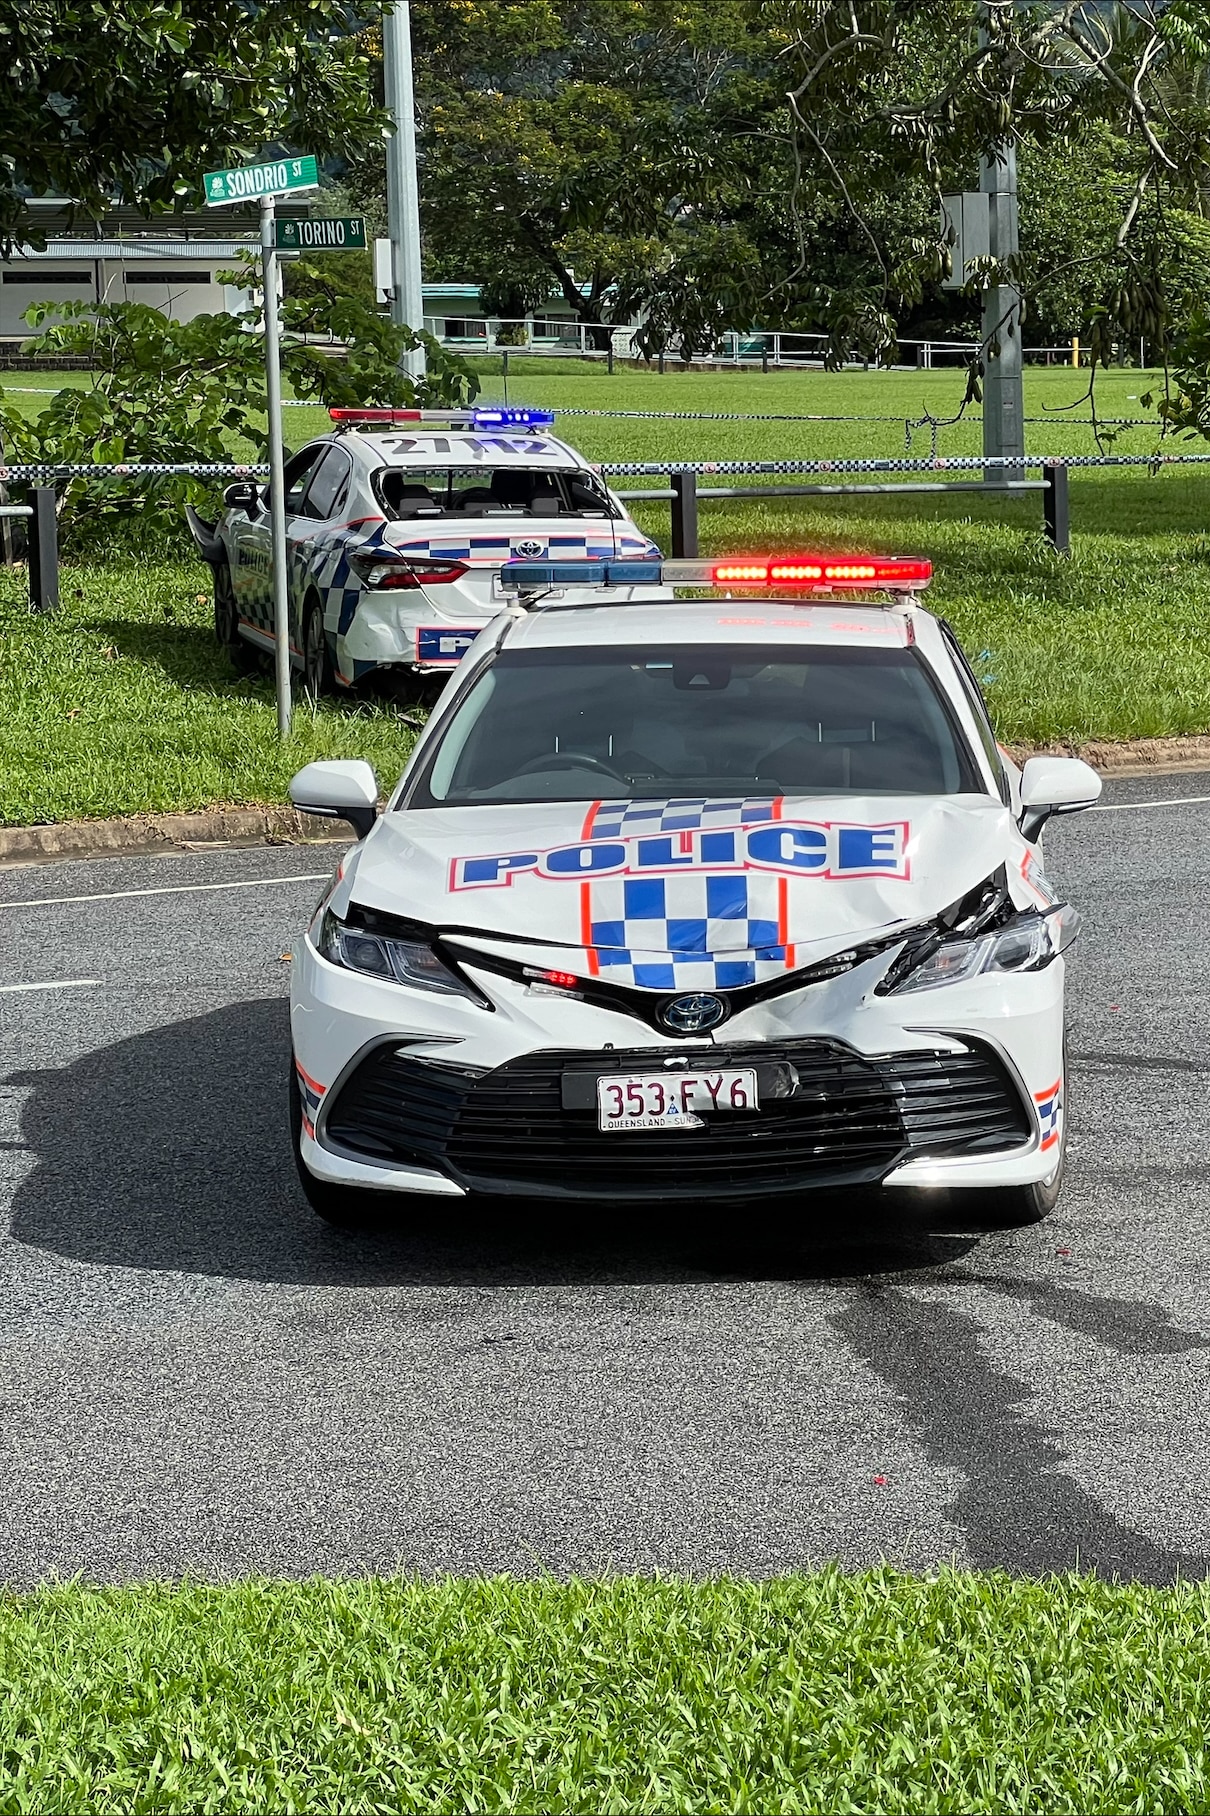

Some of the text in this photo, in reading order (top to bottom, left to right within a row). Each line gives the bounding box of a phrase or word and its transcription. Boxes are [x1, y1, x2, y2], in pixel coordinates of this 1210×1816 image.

[226, 161, 302, 197] SONDRIO ST
[297, 220, 360, 245] TORINO ST
[381, 437, 558, 456] 27112
[455, 821, 907, 888] POLICE
[608, 1117, 665, 1129] QUEENSLAND
